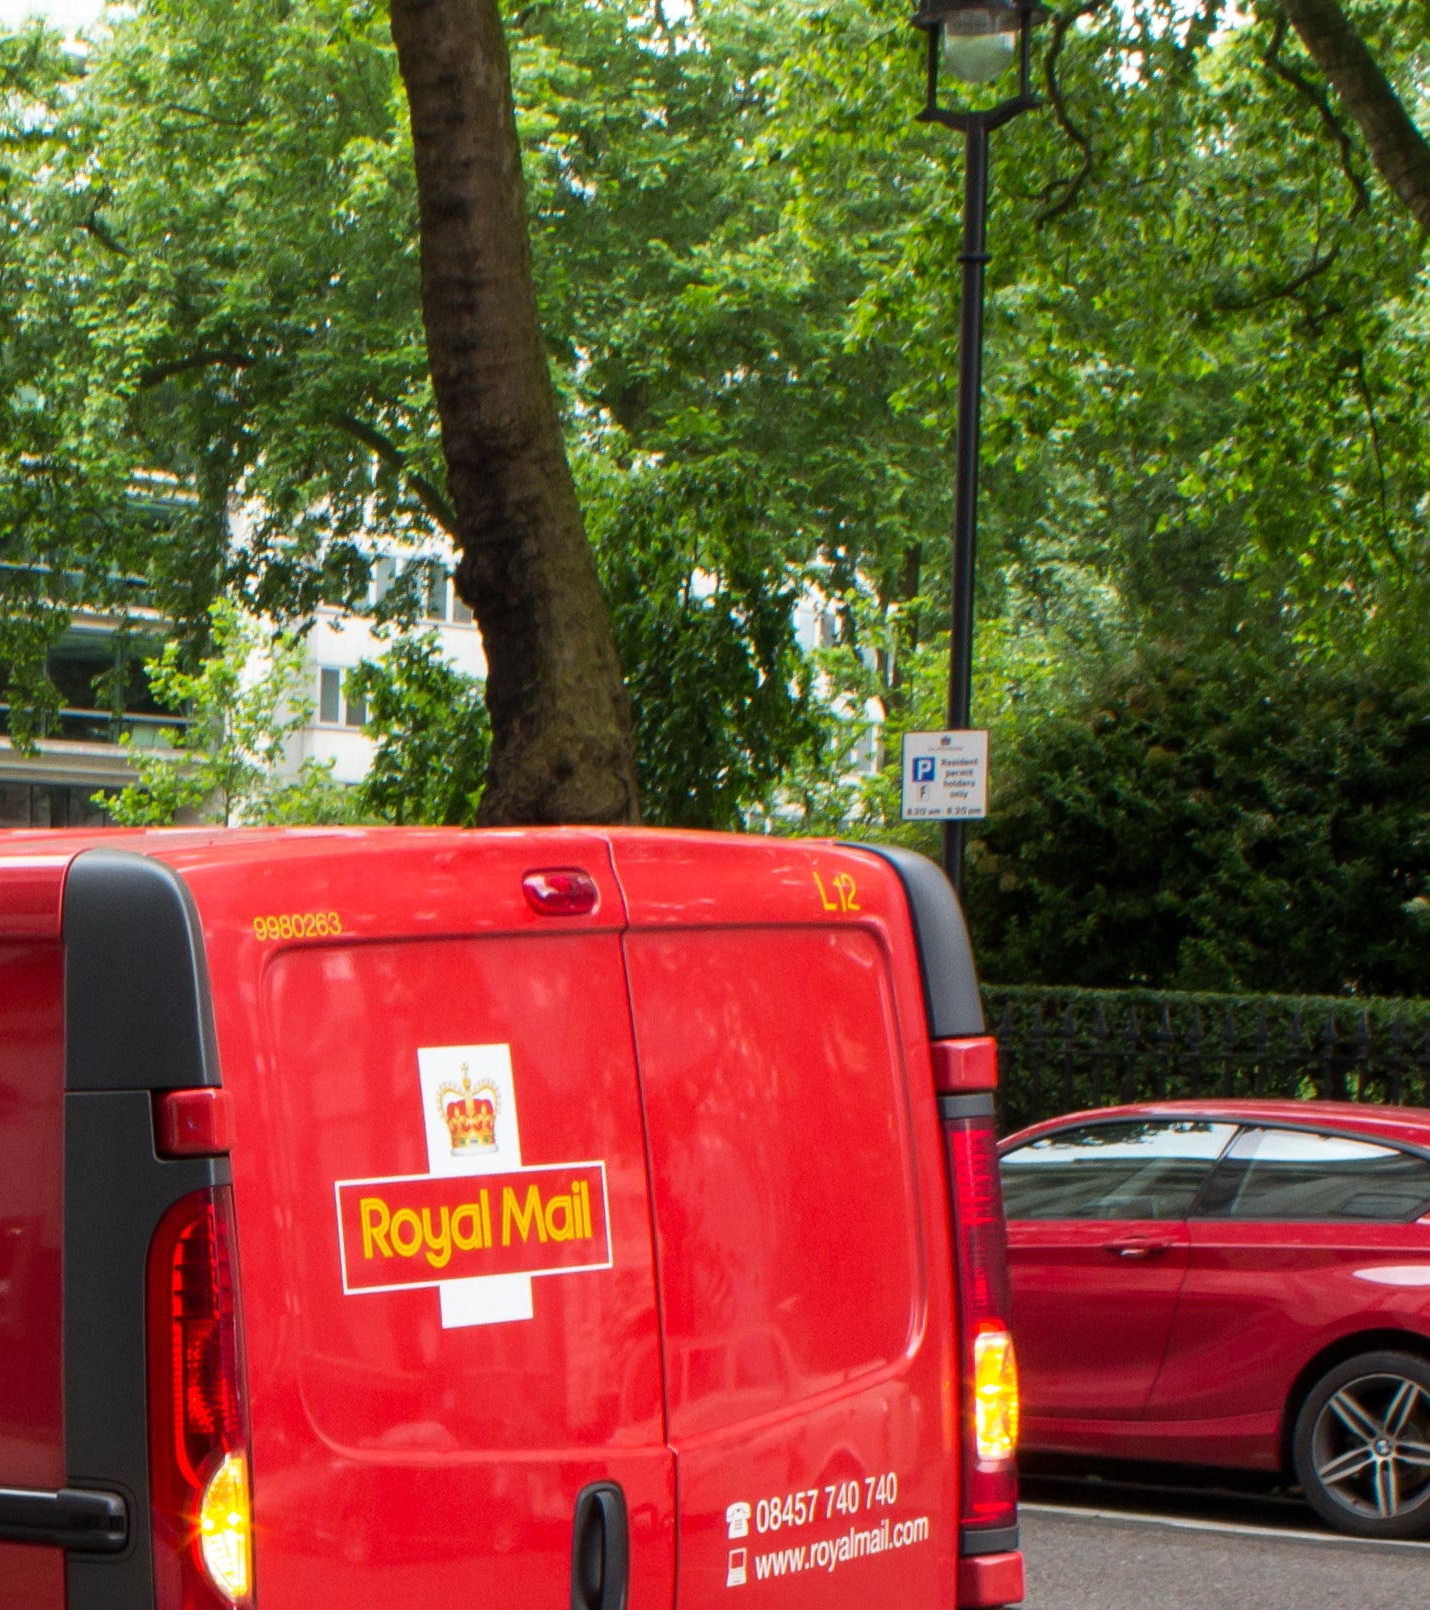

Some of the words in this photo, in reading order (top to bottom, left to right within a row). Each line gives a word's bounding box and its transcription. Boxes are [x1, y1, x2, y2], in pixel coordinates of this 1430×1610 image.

[917, 759, 933, 781] P
[940, 758, 978, 767] Resident
[945, 769, 973, 778] permit
[943, 779, 976, 787] holders
[949, 790, 969, 799] only
[253, 911, 342, 941] 9980263
[359, 1187, 492, 1269] Royal
[501, 1180, 592, 1247] Mail
[755, 1488, 819, 1534] 08457
[824, 1480, 860, 1519] 740
[864, 1471, 898, 1509] 740
[754, 1516, 929, 1580] www.royalmail.com
